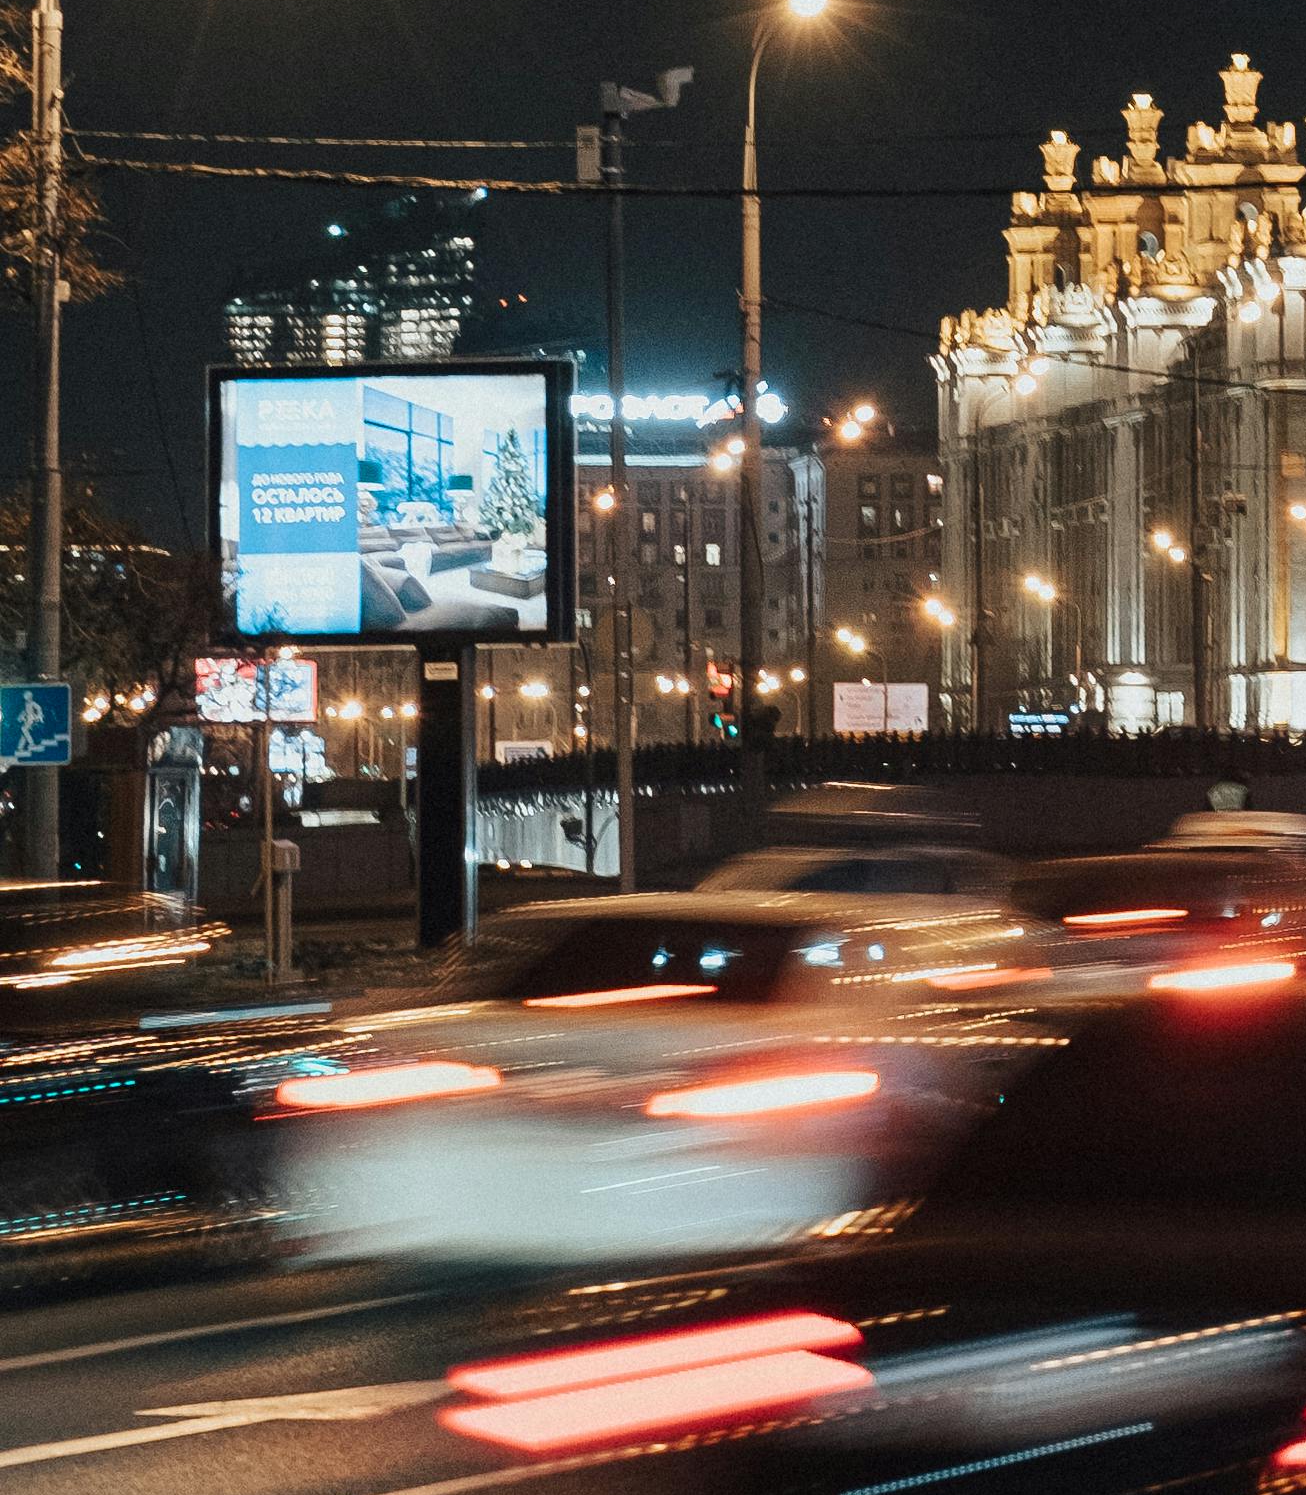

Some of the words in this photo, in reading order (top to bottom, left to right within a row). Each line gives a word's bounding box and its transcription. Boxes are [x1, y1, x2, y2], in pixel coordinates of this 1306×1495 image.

[251, 487, 345, 505] ОСТАЛОСЬ
[252, 507, 273, 524] 12
[274, 506, 346, 523] КВАРТИР
